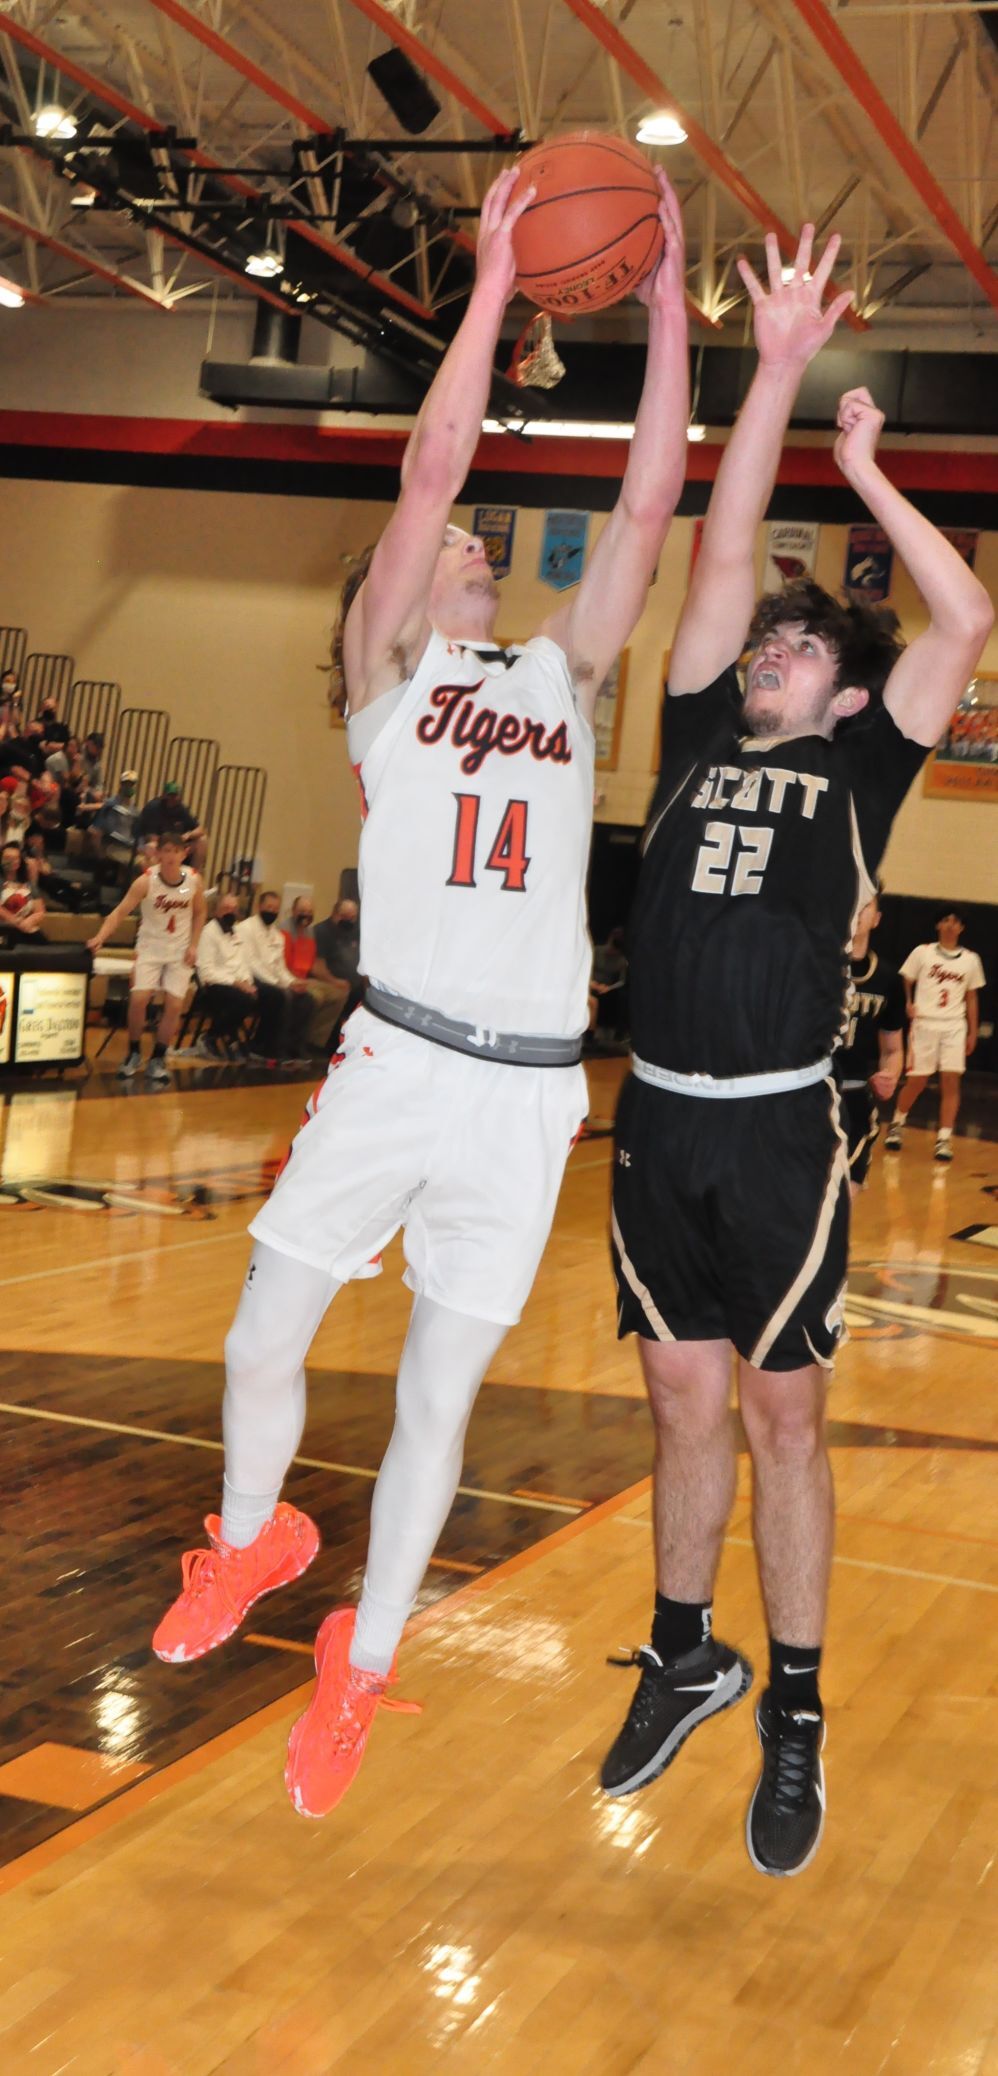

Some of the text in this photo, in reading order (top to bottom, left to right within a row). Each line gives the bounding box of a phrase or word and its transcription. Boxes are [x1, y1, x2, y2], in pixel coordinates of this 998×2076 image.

[416, 676, 572, 775] Tigers
[690, 766, 829, 820] SCOTT
[445, 791, 531, 892] 14
[691, 821, 774, 896] 22
[153, 893, 189, 913] Tigers
[164, 914, 177, 934] 4
[928, 963, 965, 984] Tigers
[938, 988, 949, 1008] 3
